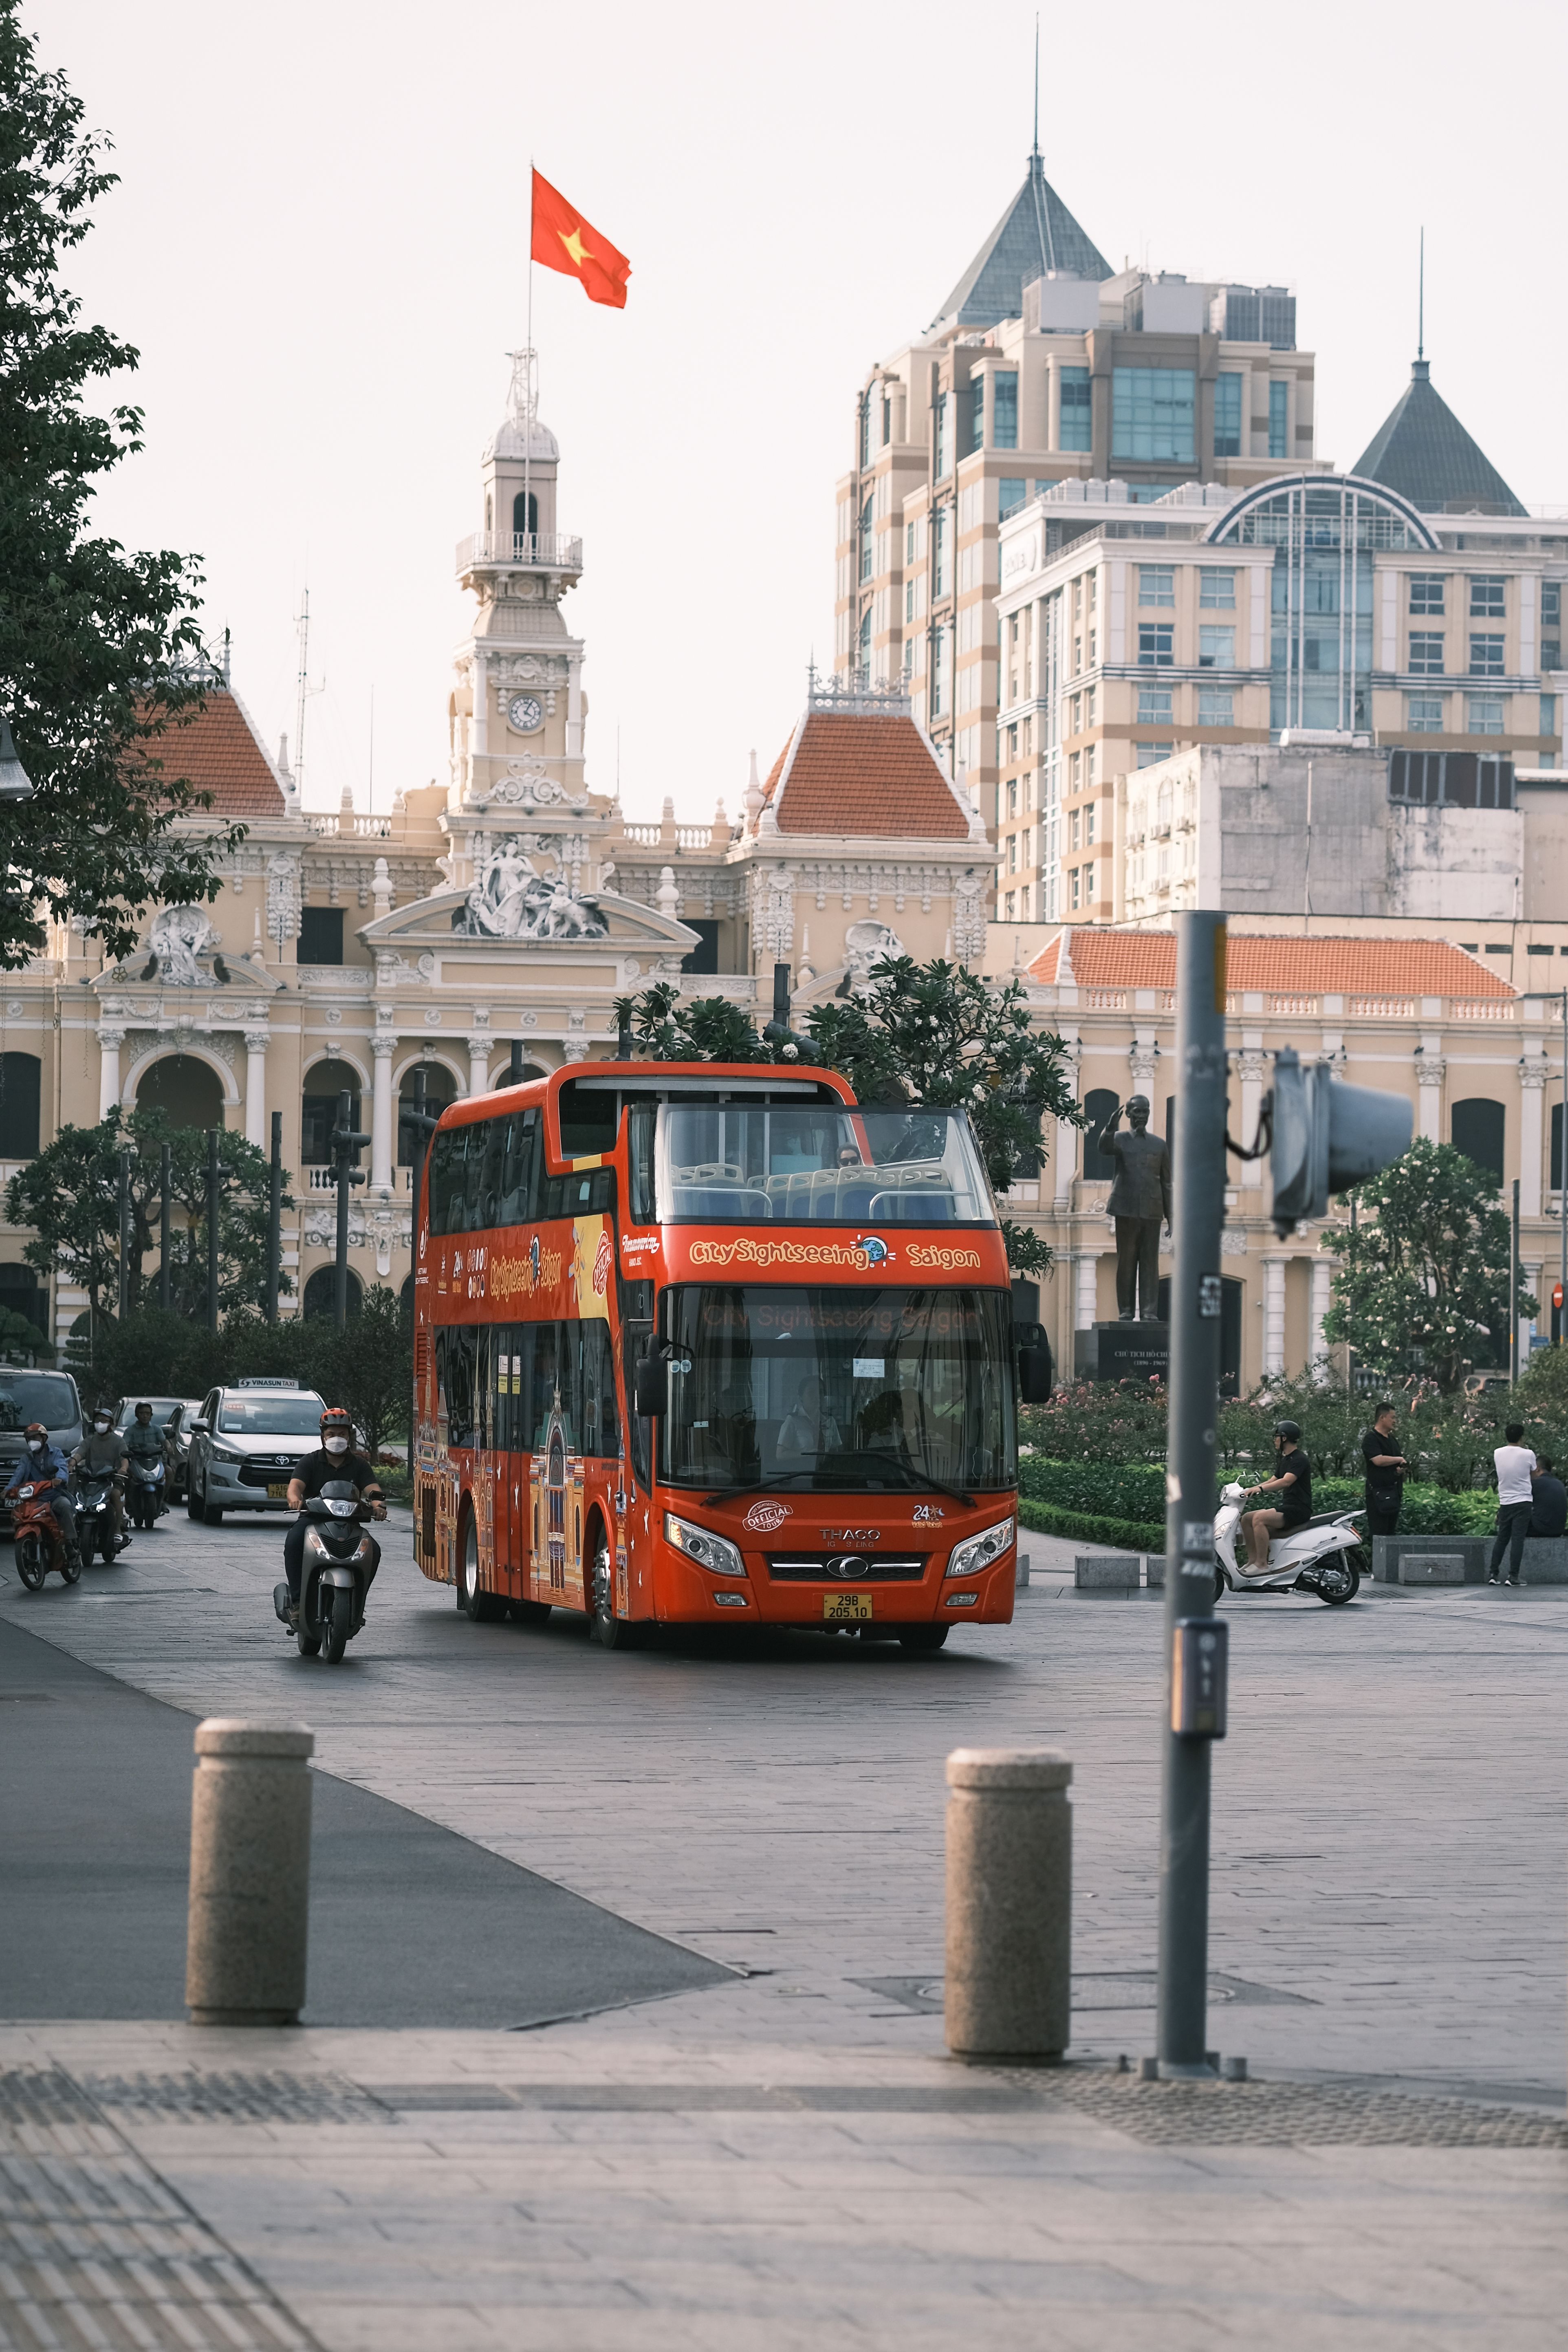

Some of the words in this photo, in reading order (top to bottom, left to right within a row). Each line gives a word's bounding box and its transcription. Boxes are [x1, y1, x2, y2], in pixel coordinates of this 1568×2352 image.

[906, 1243, 980, 1270] Saigon
[540, 1247, 561, 1292] Saigon
[594, 1246, 611, 1286] OFFICIAL
[747, 1507, 791, 1527] OFFICIAL
[913, 1505, 929, 1520] 24
[762, 1519, 782, 1529] TOUR
[819, 1529, 881, 1540] THACO
[837, 1595, 858, 1605] 29B
[829, 1607, 867, 1618] 205.10
